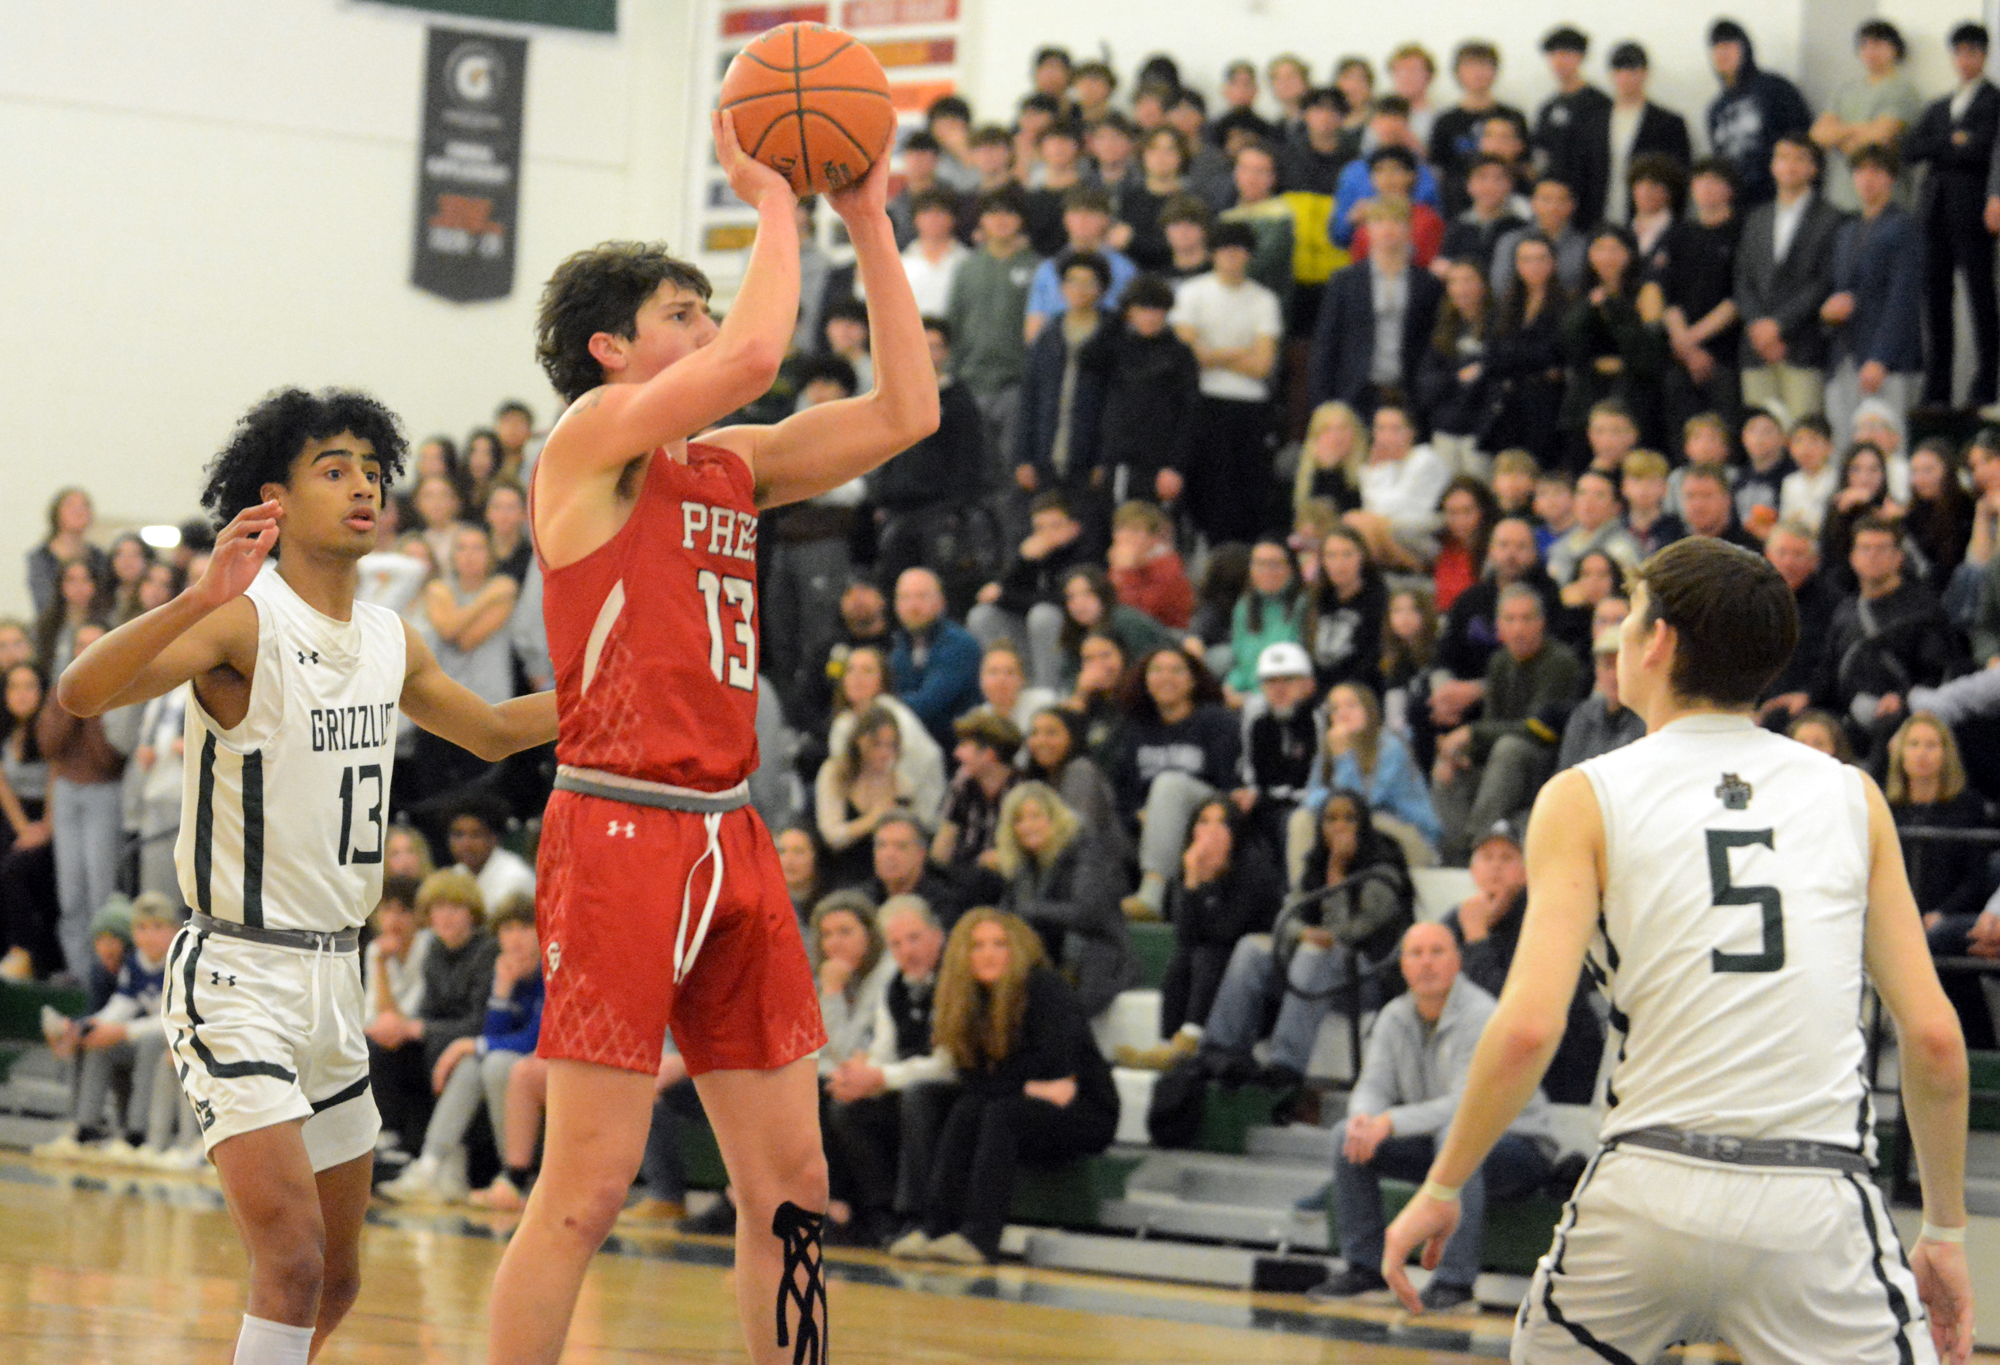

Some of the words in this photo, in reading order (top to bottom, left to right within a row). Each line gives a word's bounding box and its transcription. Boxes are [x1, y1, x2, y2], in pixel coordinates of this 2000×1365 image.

[698, 568, 755, 693] 13
[339, 764, 383, 866] 13
[1705, 827, 1785, 974] 5
